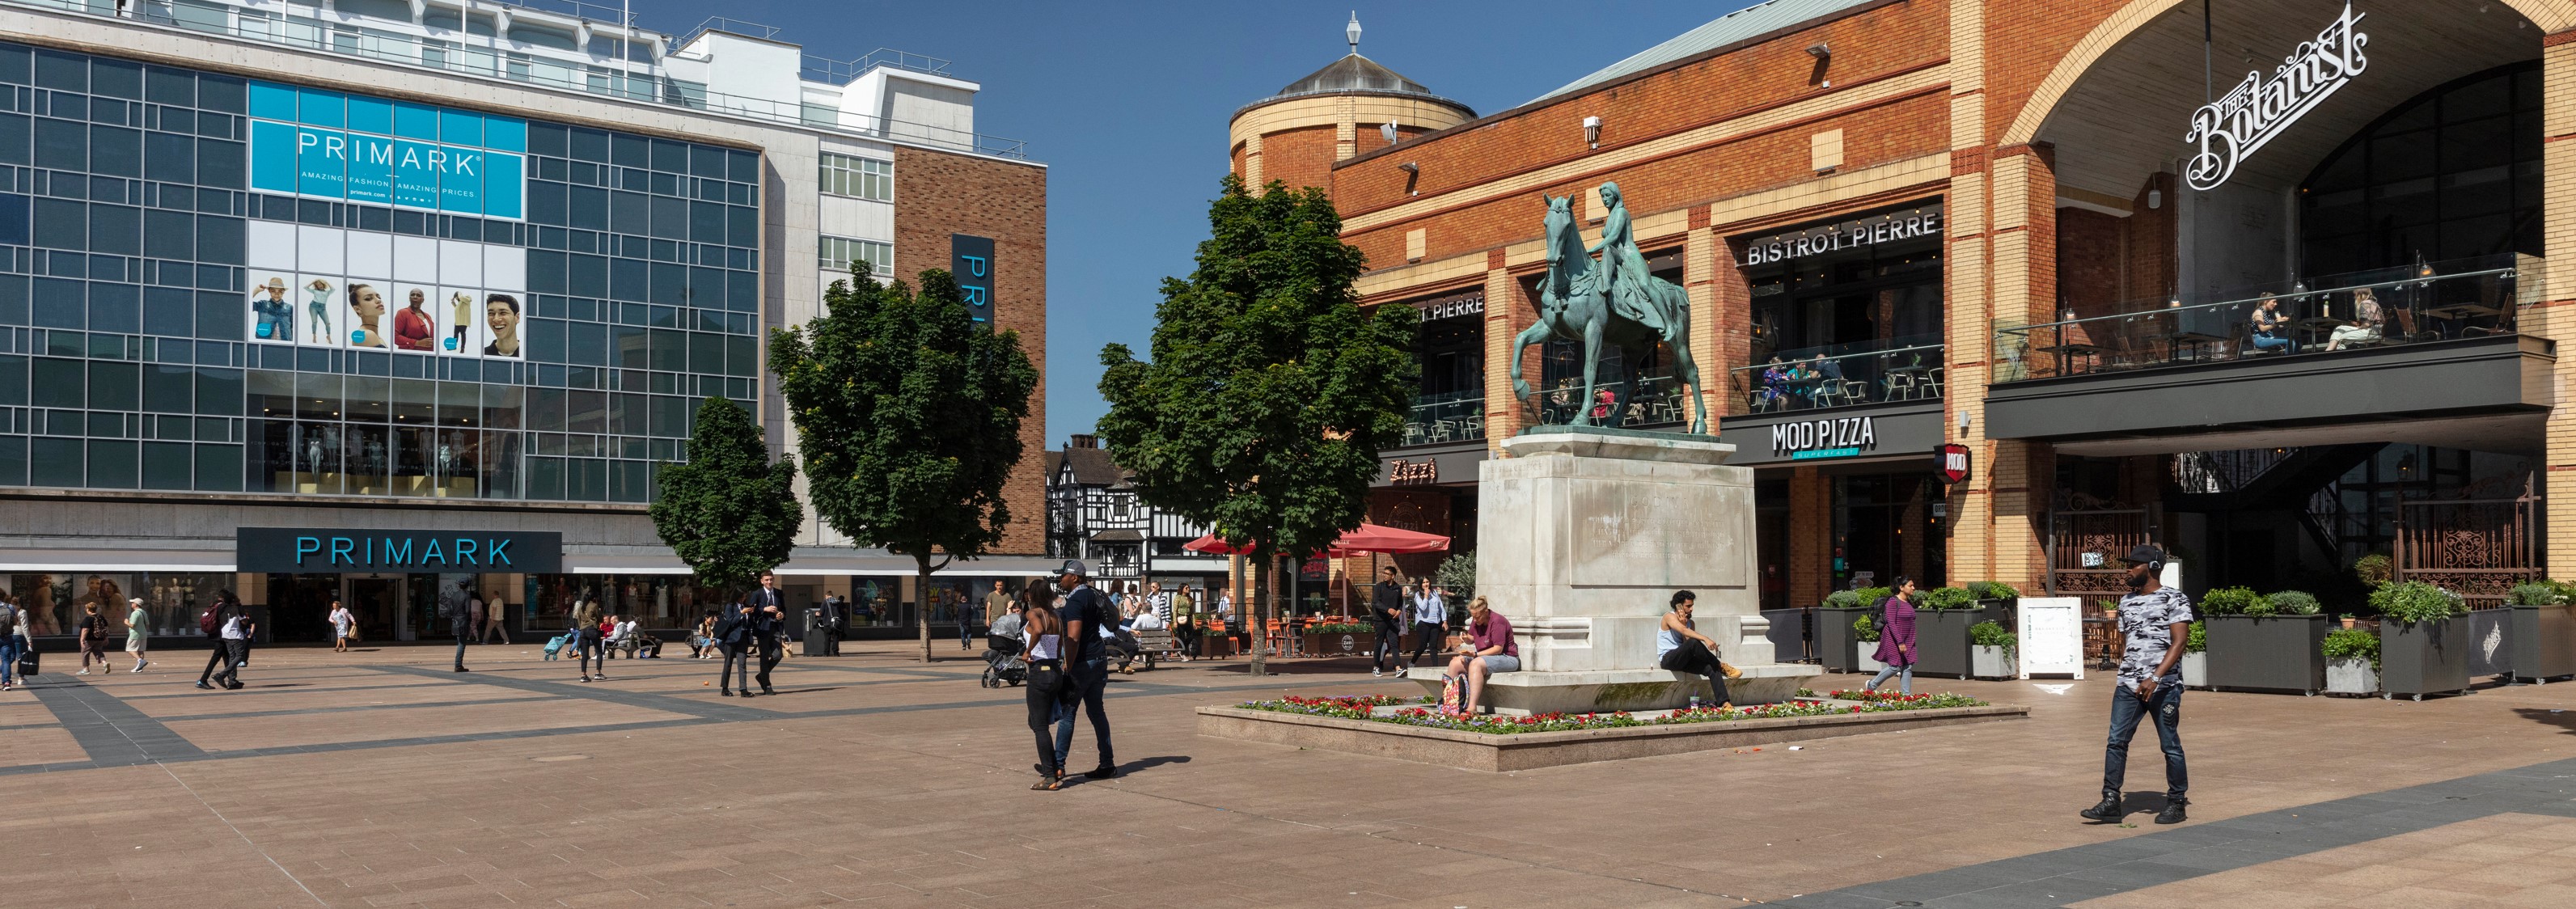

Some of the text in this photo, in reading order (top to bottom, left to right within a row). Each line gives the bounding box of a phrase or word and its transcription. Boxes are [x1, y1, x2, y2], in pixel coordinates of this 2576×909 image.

[2185, 3, 2368, 191] THE Botanist
[302, 171, 343, 182] AMAZING
[397, 183, 437, 193] AMAZING
[350, 189, 386, 198] primark.com
[1748, 213, 1936, 265] BISTROT PIERRE
[1433, 296, 1484, 320] PIERRE
[1772, 416, 1875, 450] MOD PIZZA
[1798, 450, 1854, 459] SUPERFAST
[1947, 453, 1967, 471] MOD
[1390, 458, 1436, 481] Zizzi
[1631, 496, 1689, 509] GODIVA
[297, 537, 511, 564] PRIMARK
